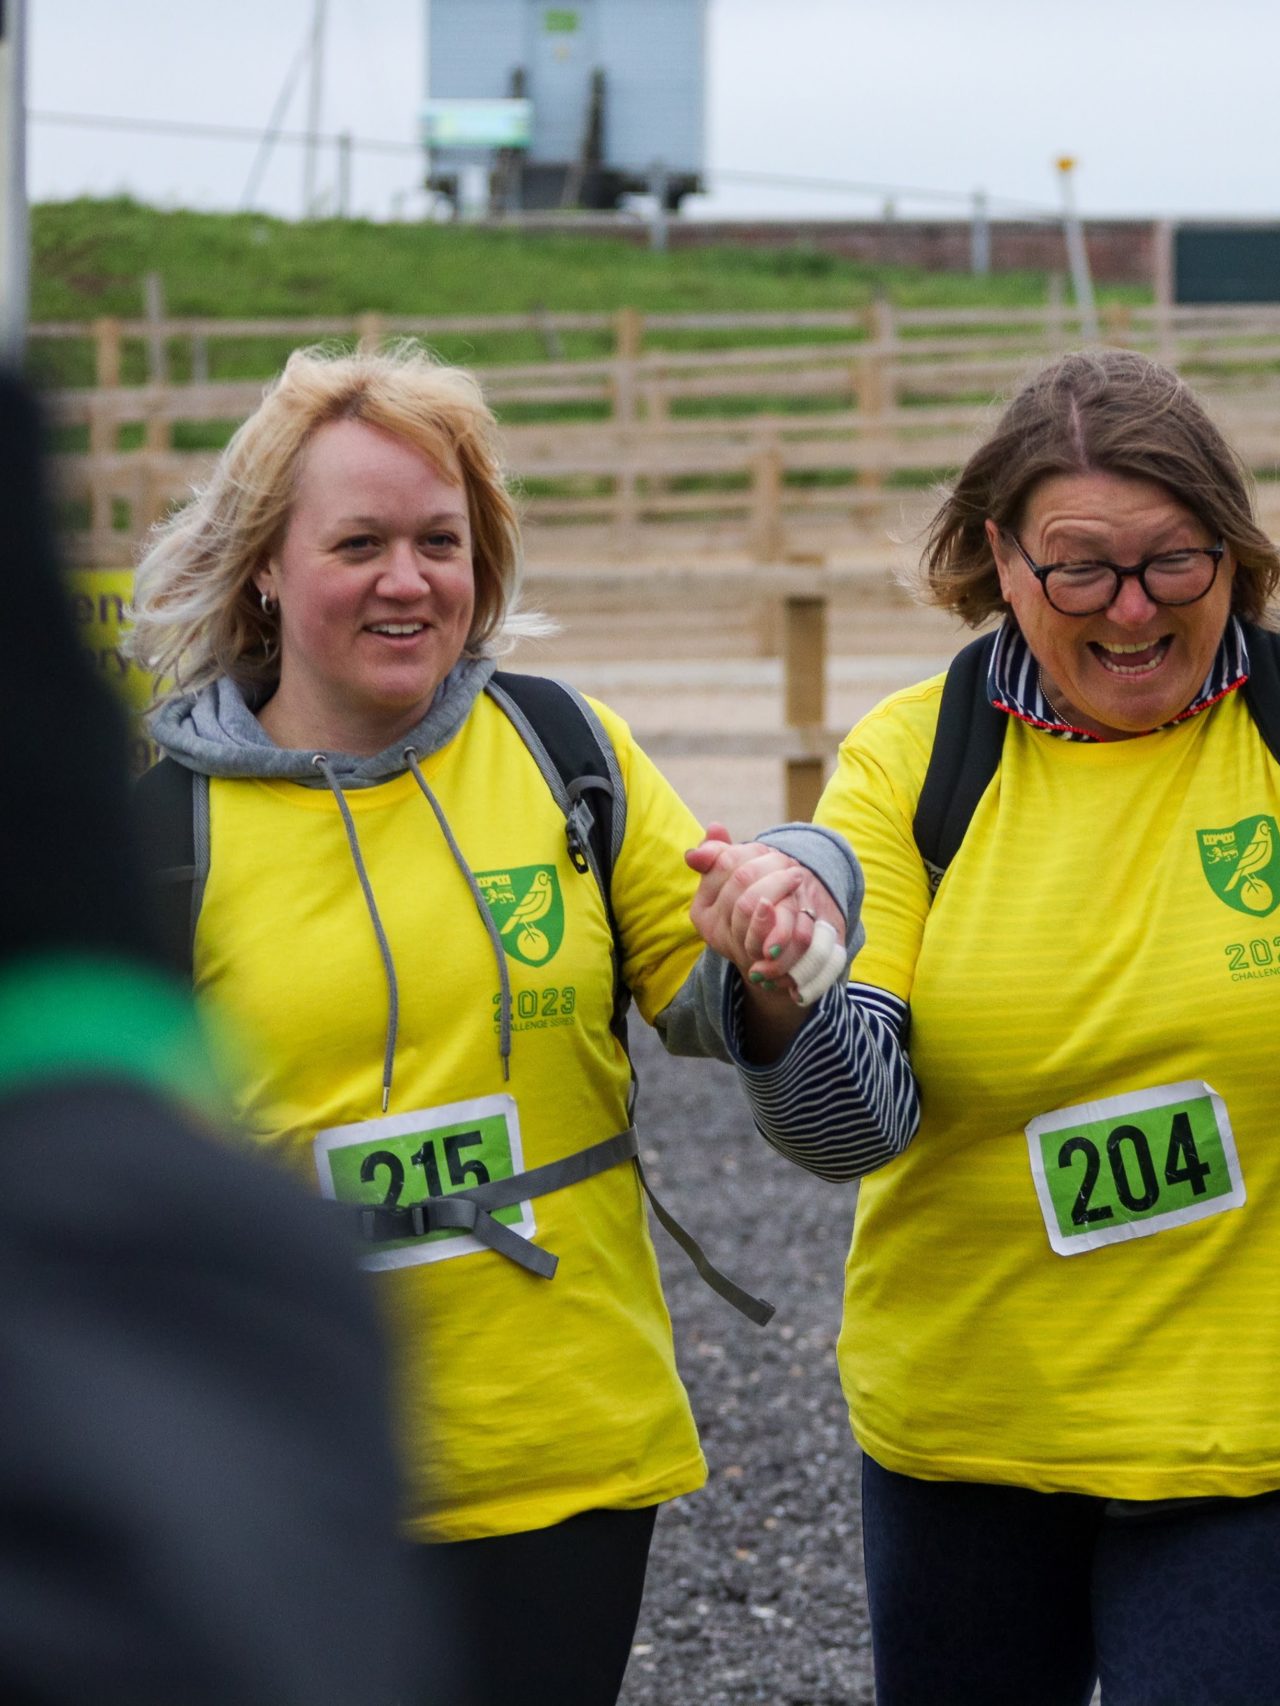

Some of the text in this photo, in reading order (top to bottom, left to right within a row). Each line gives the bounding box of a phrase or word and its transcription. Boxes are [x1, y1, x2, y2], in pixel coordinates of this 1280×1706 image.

[494, 1020, 548, 1034] CALLENGE
[360, 1130, 492, 1214] 215
[1058, 1111, 1211, 1226] 204
